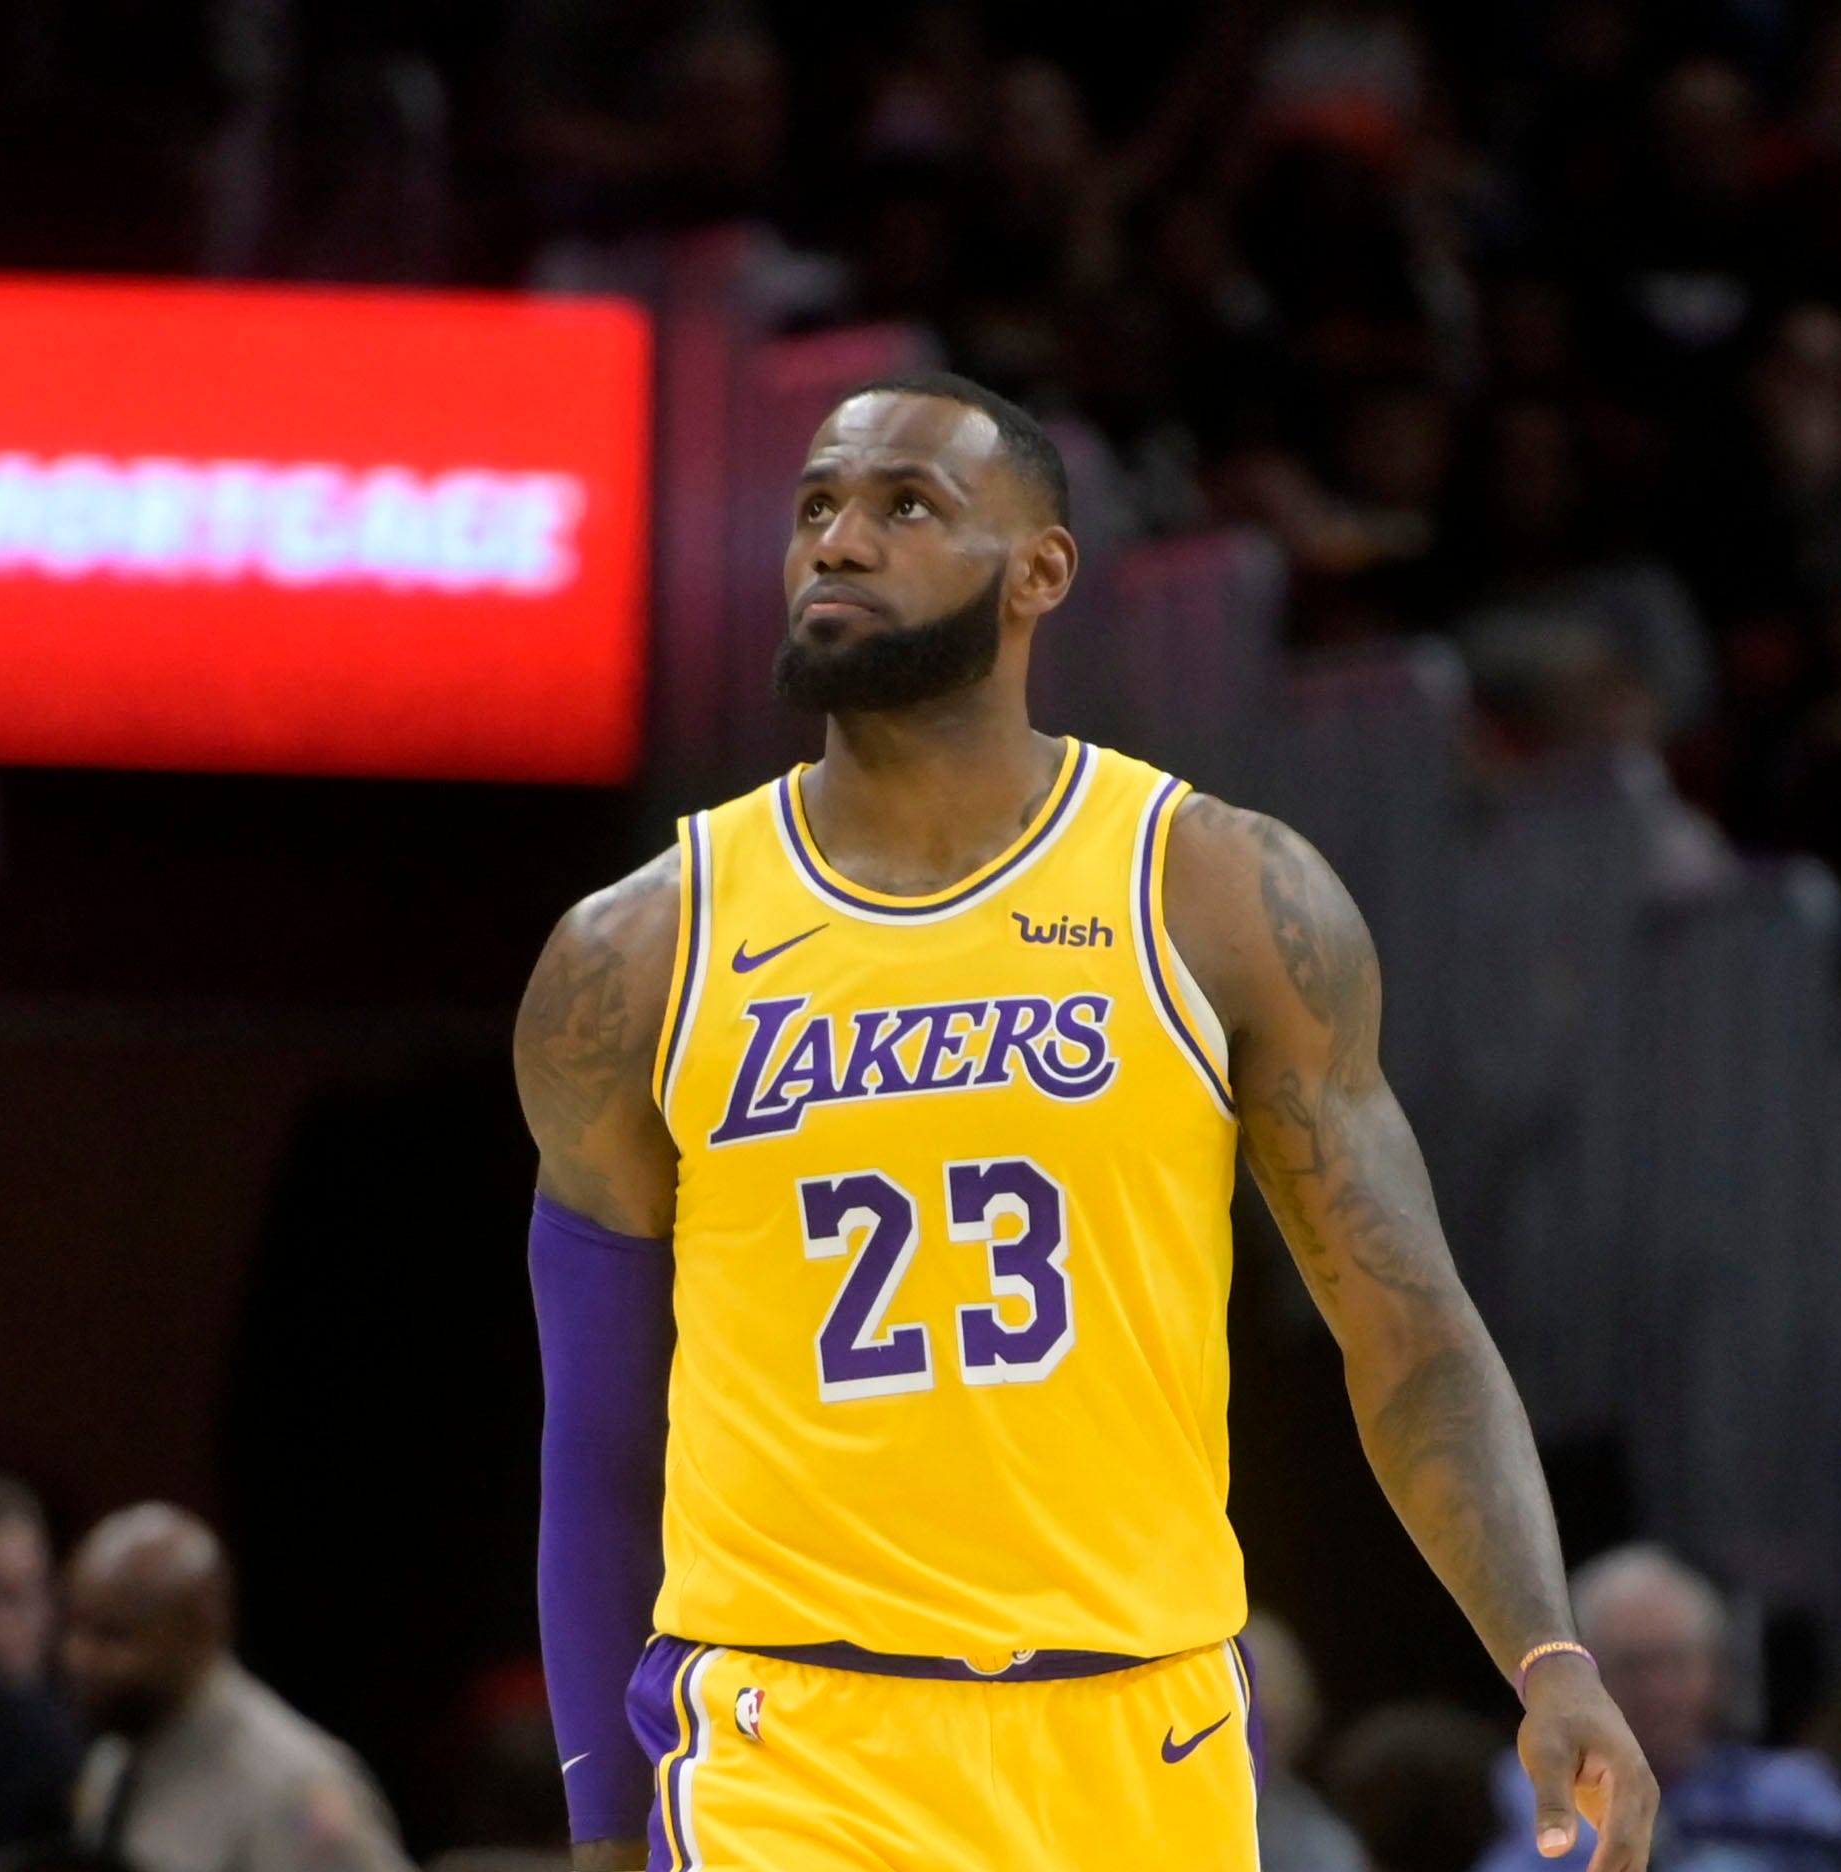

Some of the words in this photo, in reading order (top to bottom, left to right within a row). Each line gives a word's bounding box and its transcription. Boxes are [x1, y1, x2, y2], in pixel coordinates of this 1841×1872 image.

[1010, 911, 1114, 948] wish
[707, 991, 1121, 1149] LAKERS
[795, 1155, 1076, 1404] 23
